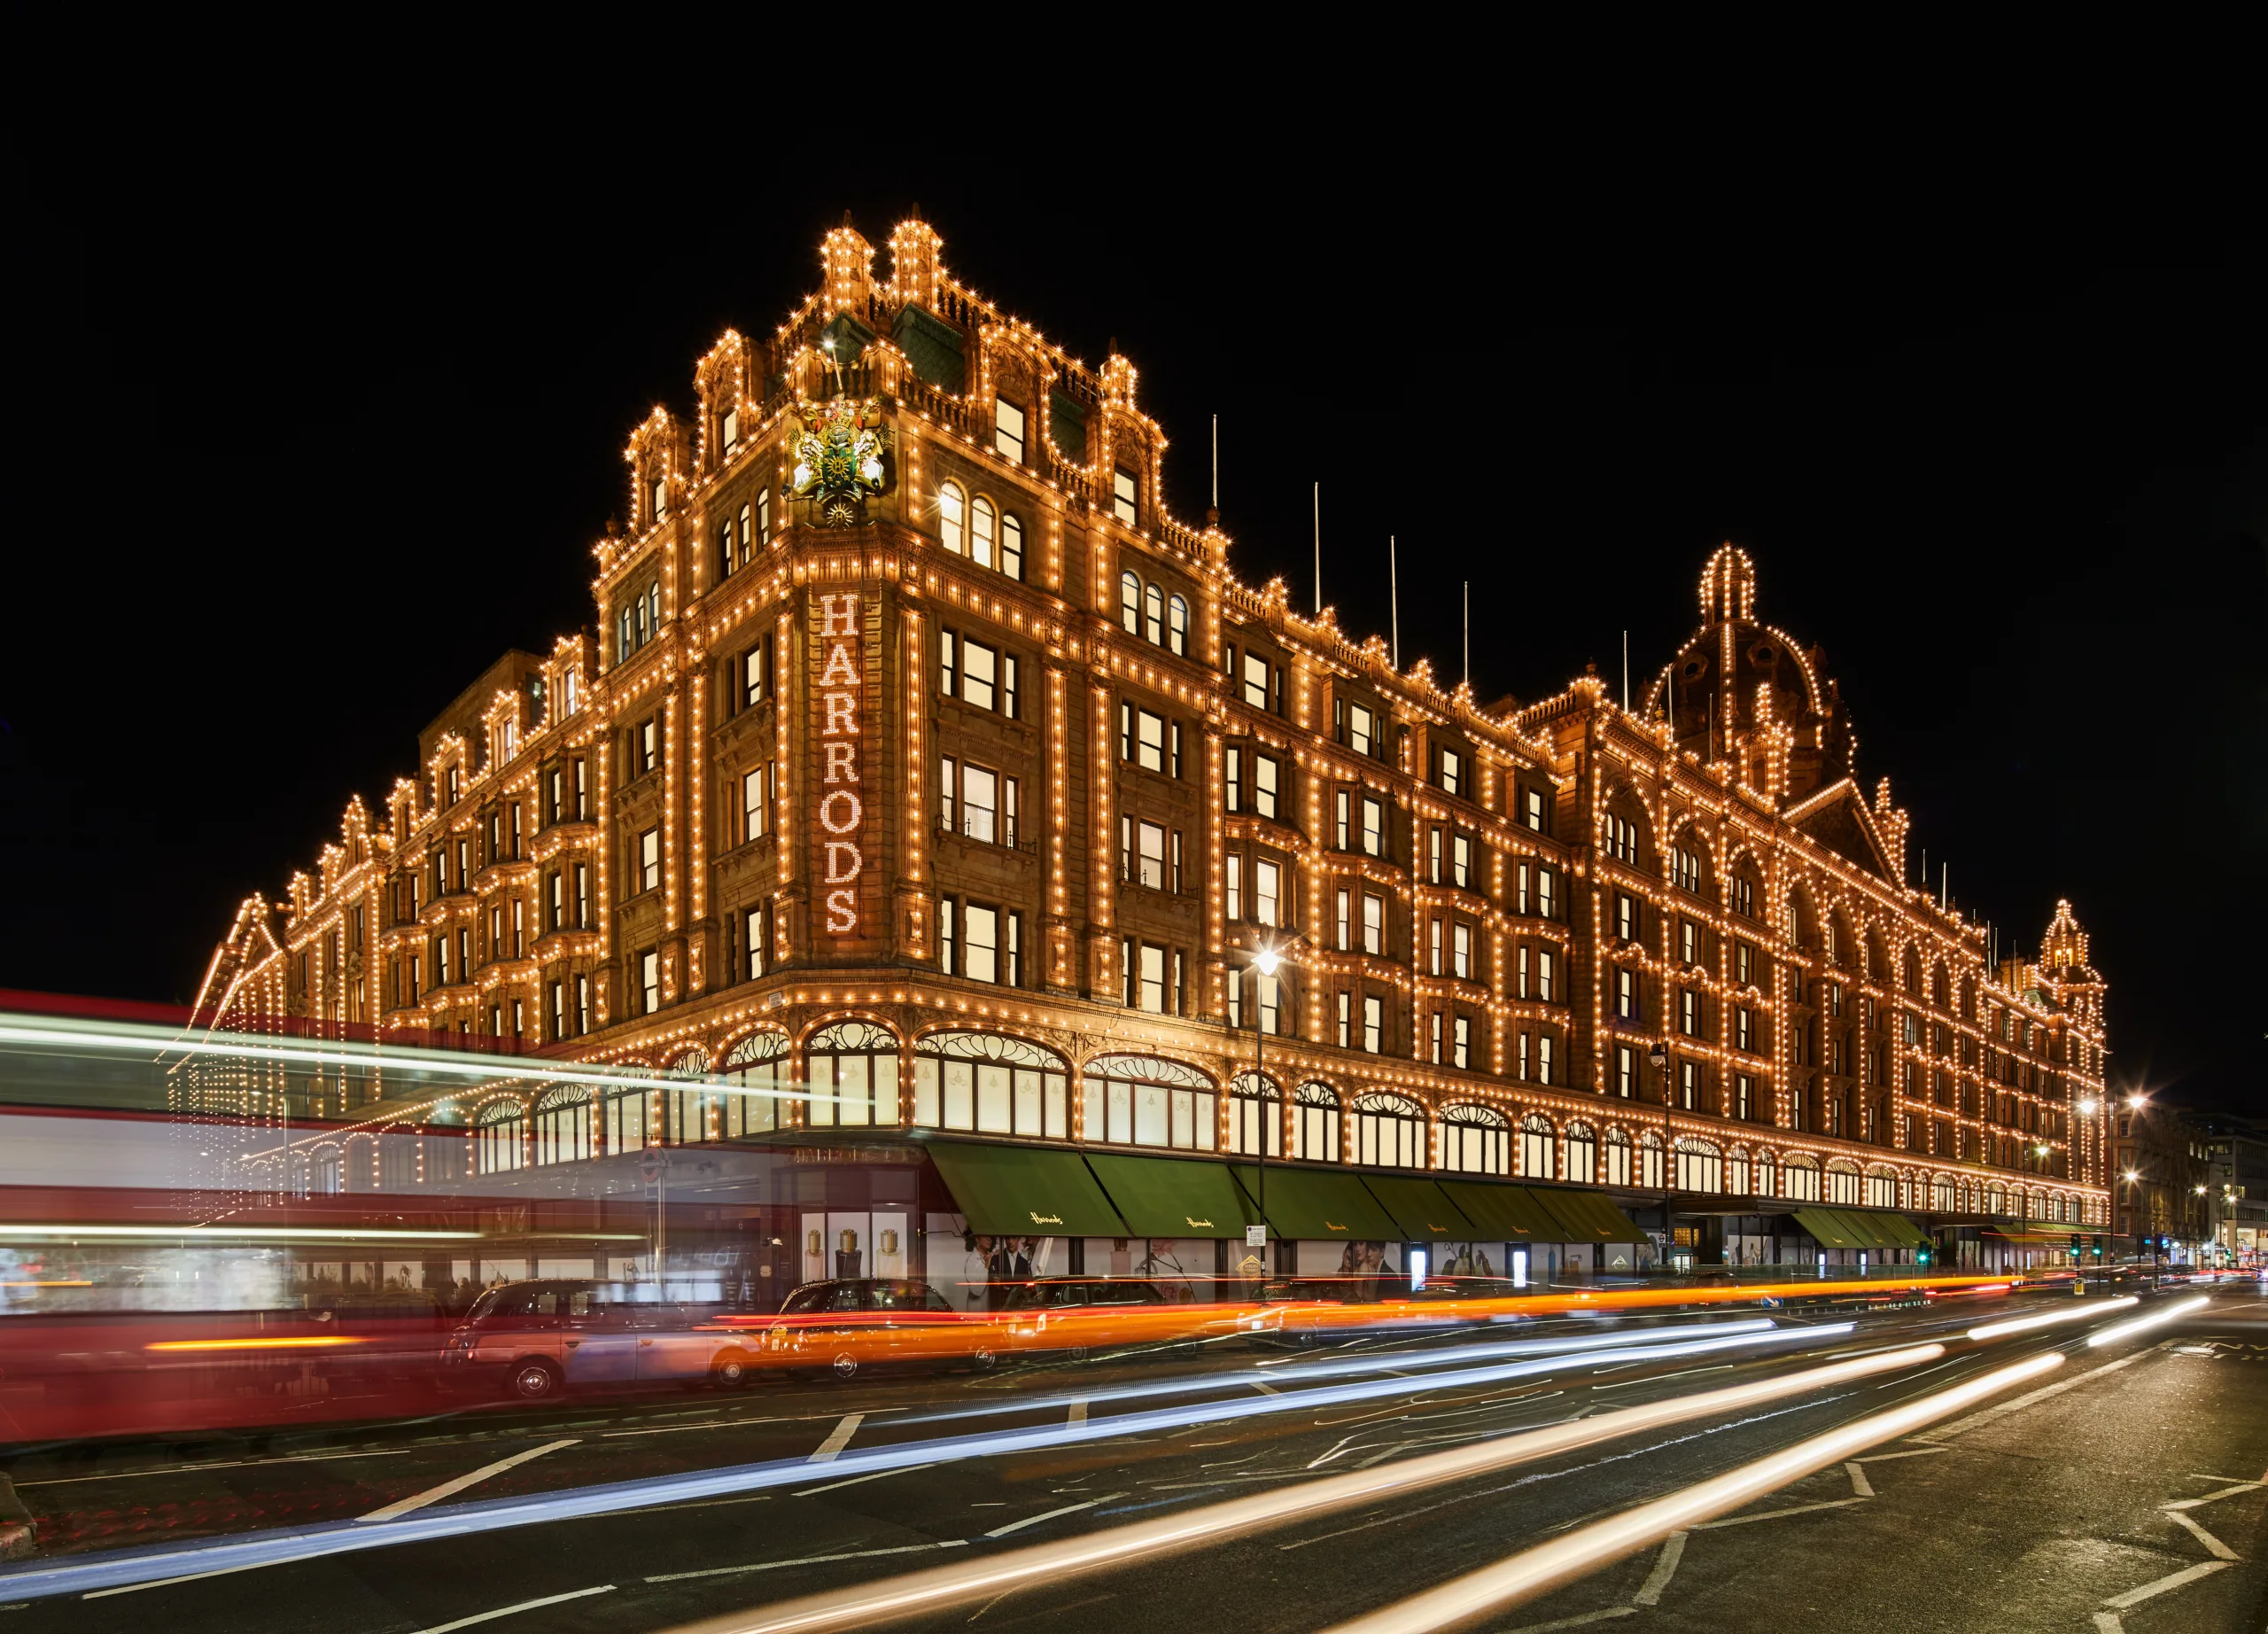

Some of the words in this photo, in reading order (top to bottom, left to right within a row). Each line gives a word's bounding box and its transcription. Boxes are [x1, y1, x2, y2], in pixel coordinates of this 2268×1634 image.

[819, 594, 862, 932] HARRODS
[1030, 1211, 1063, 1225] Harrods
[1186, 1217, 1214, 1228] Harrods
